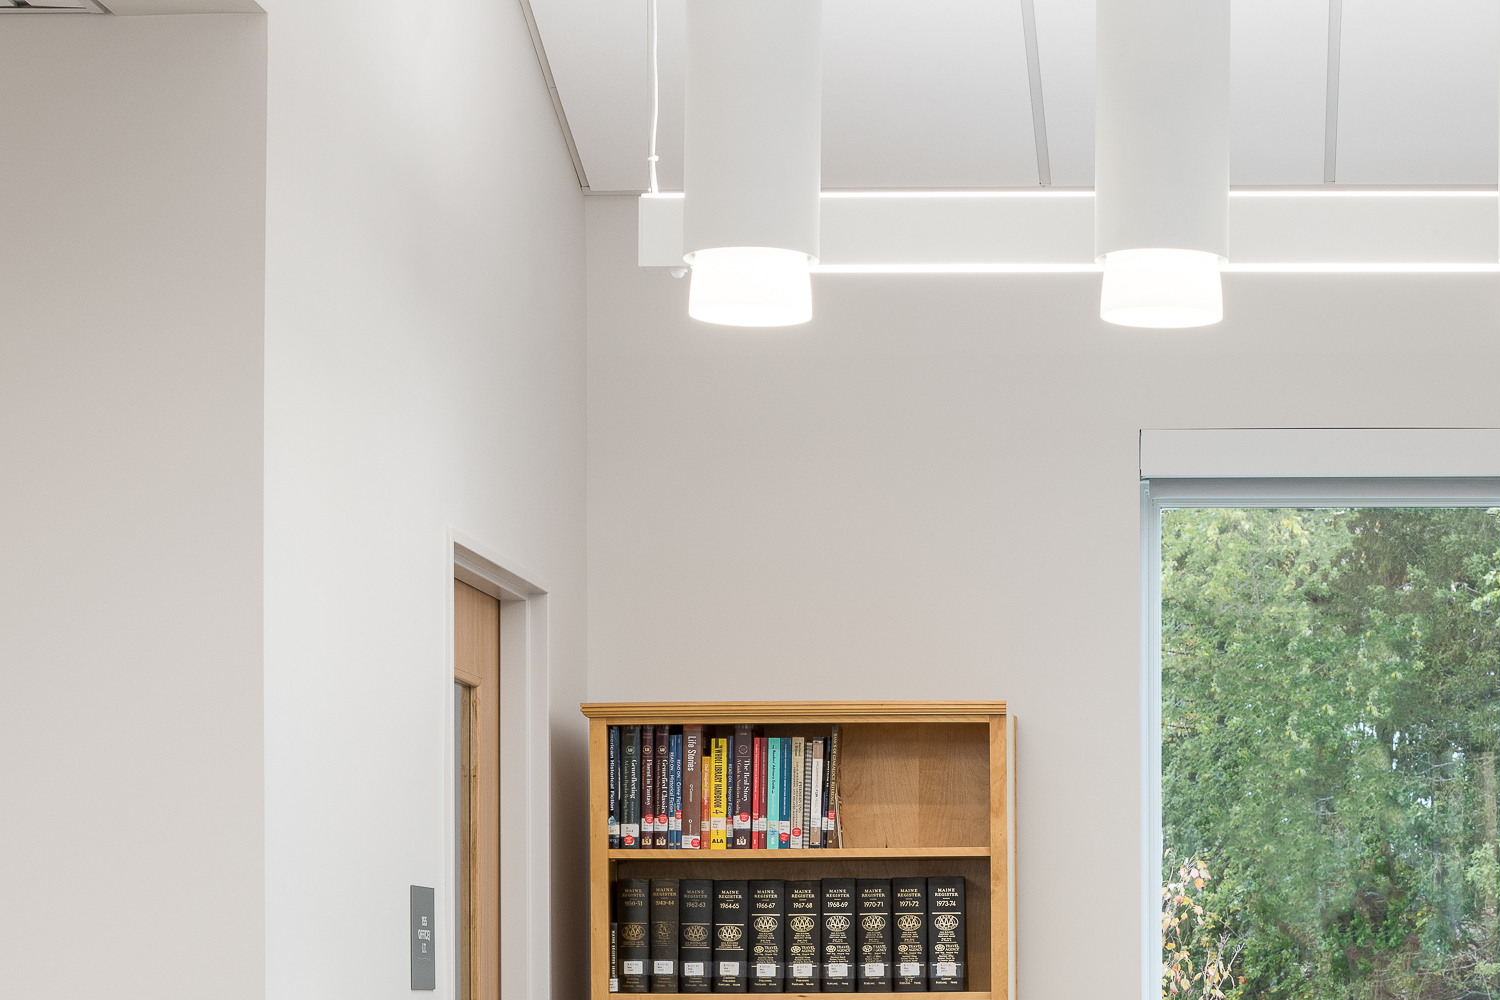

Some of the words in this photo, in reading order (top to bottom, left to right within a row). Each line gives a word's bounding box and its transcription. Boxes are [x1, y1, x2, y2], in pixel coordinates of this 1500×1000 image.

[688, 736, 696, 748] Life
[687, 750, 696, 771] Stories
[715, 749, 723, 763] WHOLE
[714, 765, 722, 783] LIBRARY
[714, 784, 722, 808] HANDBOOK
